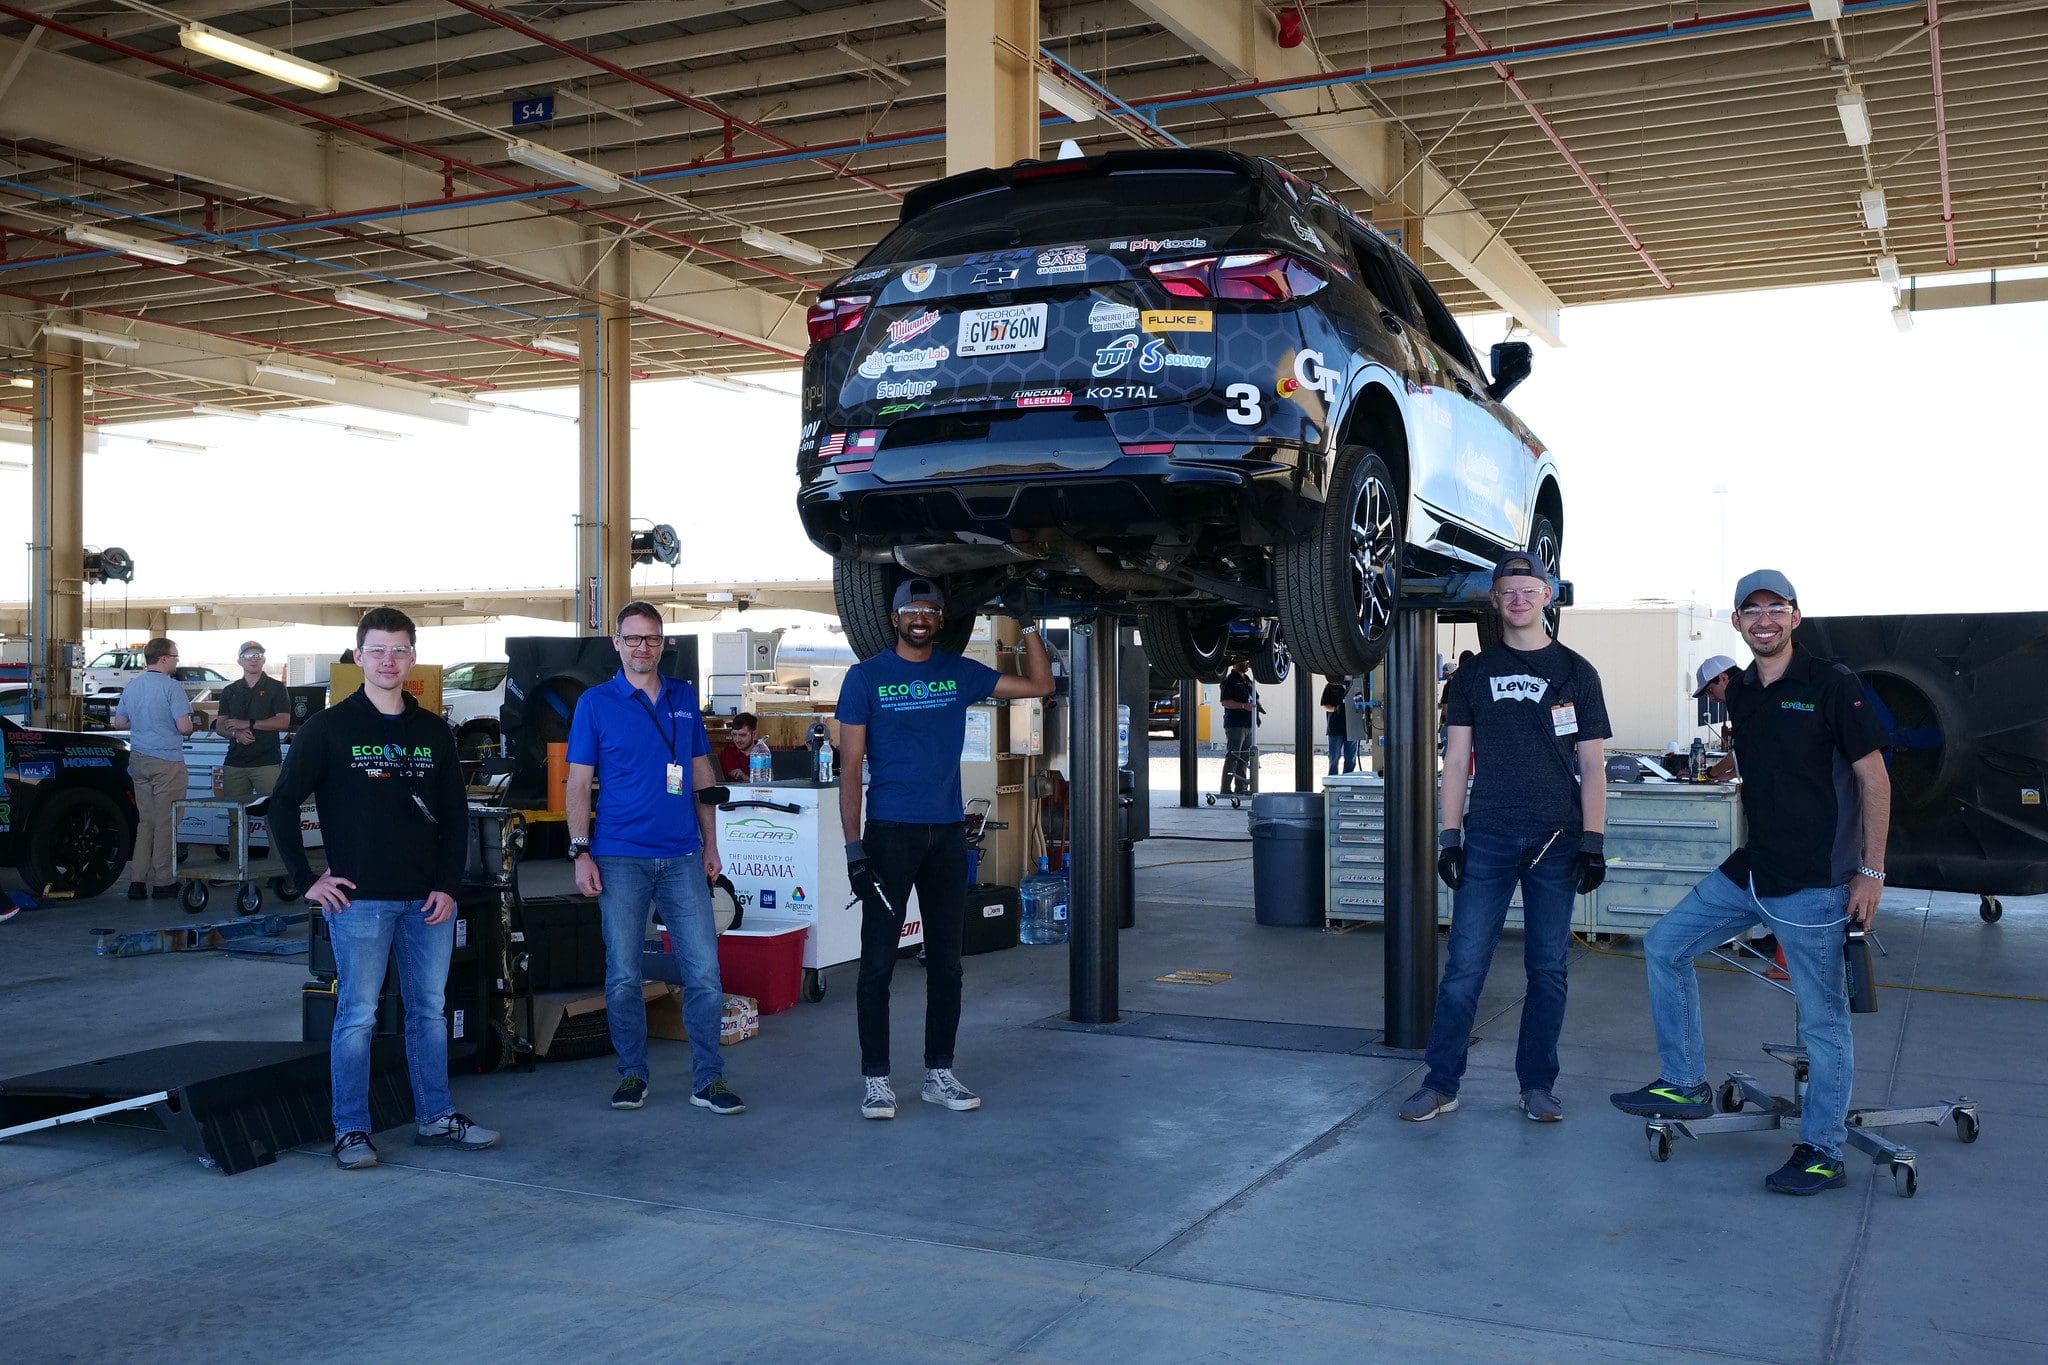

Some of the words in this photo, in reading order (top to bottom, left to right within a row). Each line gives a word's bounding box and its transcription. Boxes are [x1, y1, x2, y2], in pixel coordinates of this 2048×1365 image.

[522, 102, 544, 120] S-4
[1130, 238, 1206, 251] phytools
[1038, 253, 1086, 267] CARS
[979, 309, 1026, 321] GEORGIA
[1090, 314, 1121, 324] ENGINEERED
[1148, 315, 1197, 325] FLUKE
[887, 310, 940, 342] Milwaukee
[970, 316, 1040, 343] GV5760N
[884, 351, 927, 365] Curiosity
[928, 348, 948, 360] Lab
[1166, 356, 1210, 368] SOLVAY
[877, 380, 933, 399] Sendyne
[1014, 389, 1063, 398] LINCOLN
[1086, 386, 1158, 399] KOSTAL
[1023, 396, 1066, 405] ELECTRIC
[1226, 383, 1262, 425] 3
[878, 684, 909, 697] ECO
[928, 680, 957, 692] CAR
[64, 747, 116, 757] SIEMENS
[351, 745, 383, 757] ECO
[727, 862, 794, 878] ALABAMA
[785, 901, 813, 911] Argonne
